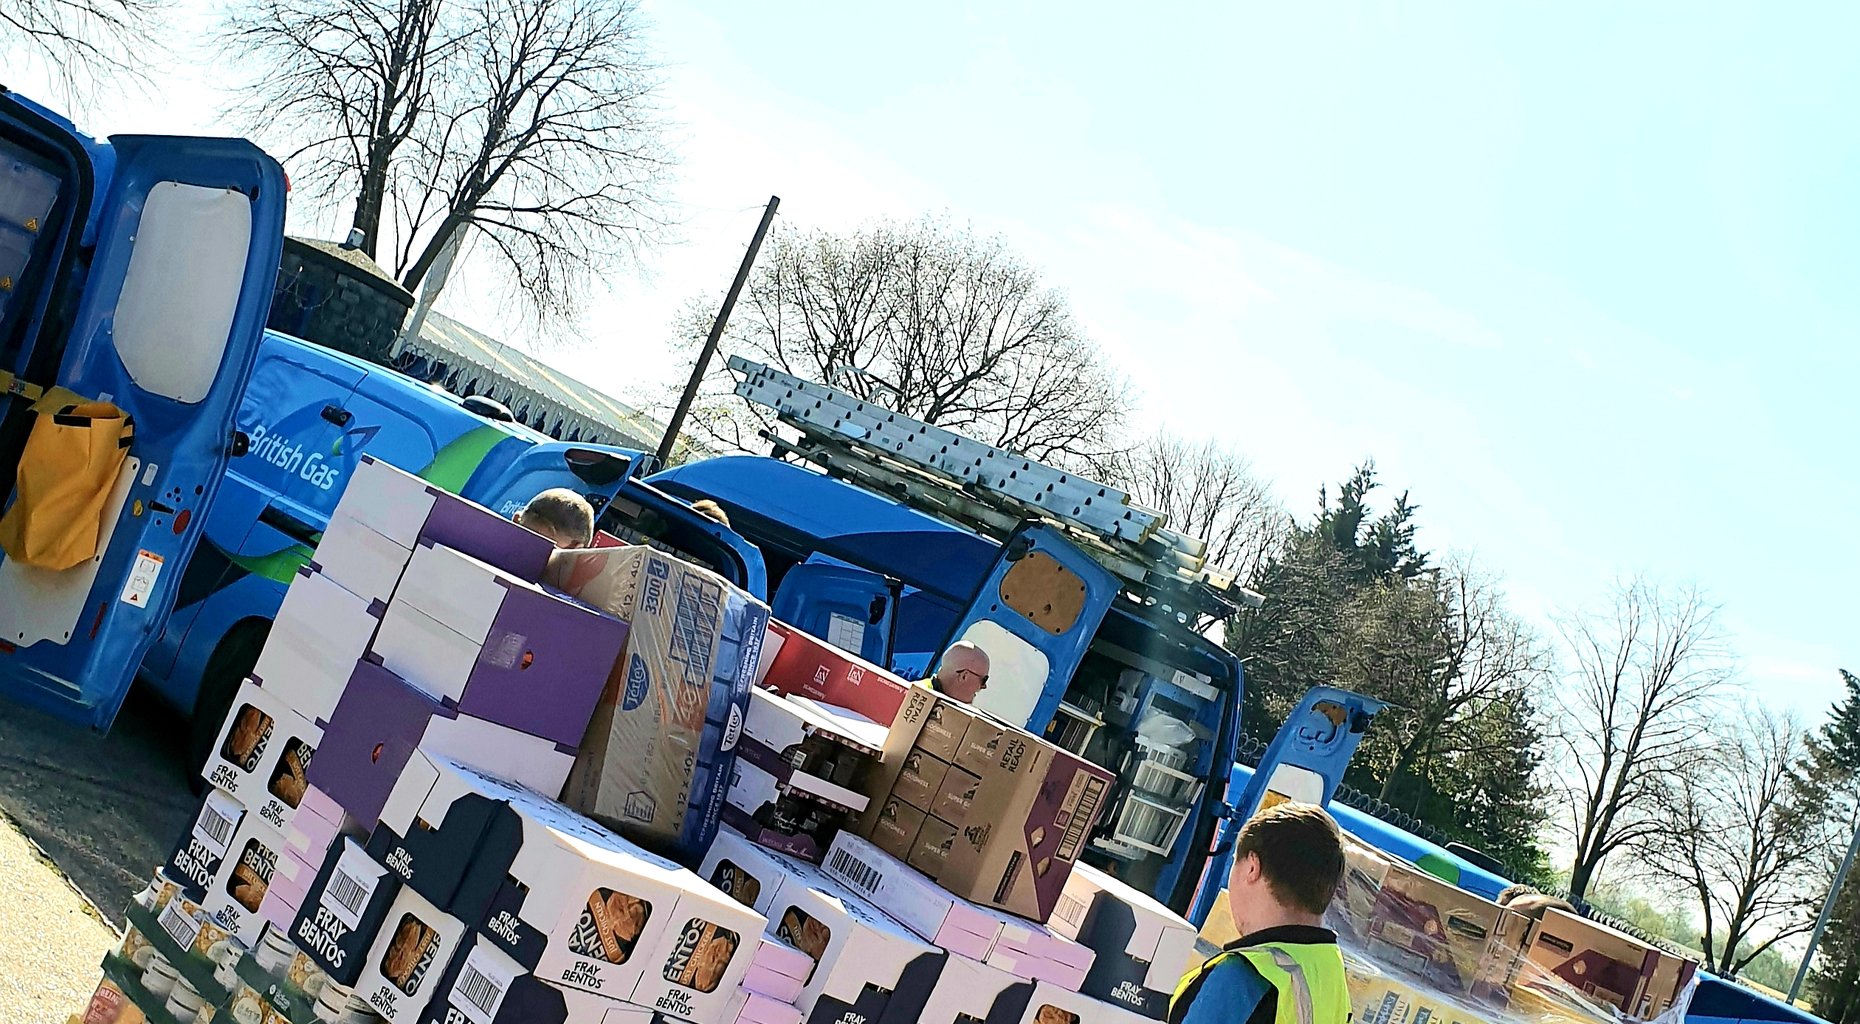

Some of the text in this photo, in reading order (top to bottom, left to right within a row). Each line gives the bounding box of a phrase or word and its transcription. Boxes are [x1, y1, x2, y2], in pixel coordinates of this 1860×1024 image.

[248, 425, 339, 490] British Gas
[500, 500, 527, 514] Briti
[646, 577, 661, 617] 3300
[749, 616, 758, 645] BRITAIN
[627, 666, 648, 710] Tetley
[903, 691, 921, 723] READY
[909, 694, 928, 724] RETAIL
[724, 711, 741, 746] Tetley
[1000, 738, 1020, 769] RETAIL
[1009, 740, 1027, 773] READY
[216, 765, 238, 780] FRAY
[712, 763, 724, 795] BRITAIN
[268, 800, 285, 815] FRAY
[677, 791, 687, 806] 12
[260, 807, 286, 828] BENTOS
[187, 838, 217, 868] FRAY
[256, 843, 280, 865] FRA
[394, 847, 413, 865] FRAY
[174, 849, 217, 890] BENTOS
[385, 852, 414, 880] BENTOS
[216, 911, 241, 933] BENTOS
[225, 905, 241, 920] FRAY
[314, 906, 348, 940] FRAY
[499, 910, 521, 929] FRAY
[487, 917, 521, 946] BENTOS
[298, 917, 348, 969] BENTOS
[667, 918, 706, 981] ENTOS
[562, 969, 605, 989] BENTOS
[574, 961, 601, 975] FRAY
[680, 964, 692, 985] UST
[379, 986, 398, 1005] FRAY
[667, 989, 692, 1003] FRAY
[1110, 987, 1144, 1007] BENTOS
[1120, 980, 1142, 995] FRAY
[370, 993, 398, 1019] BENTOS
[655, 997, 694, 1016] BENTOS
[843, 1011, 866, 1024] FRAY
